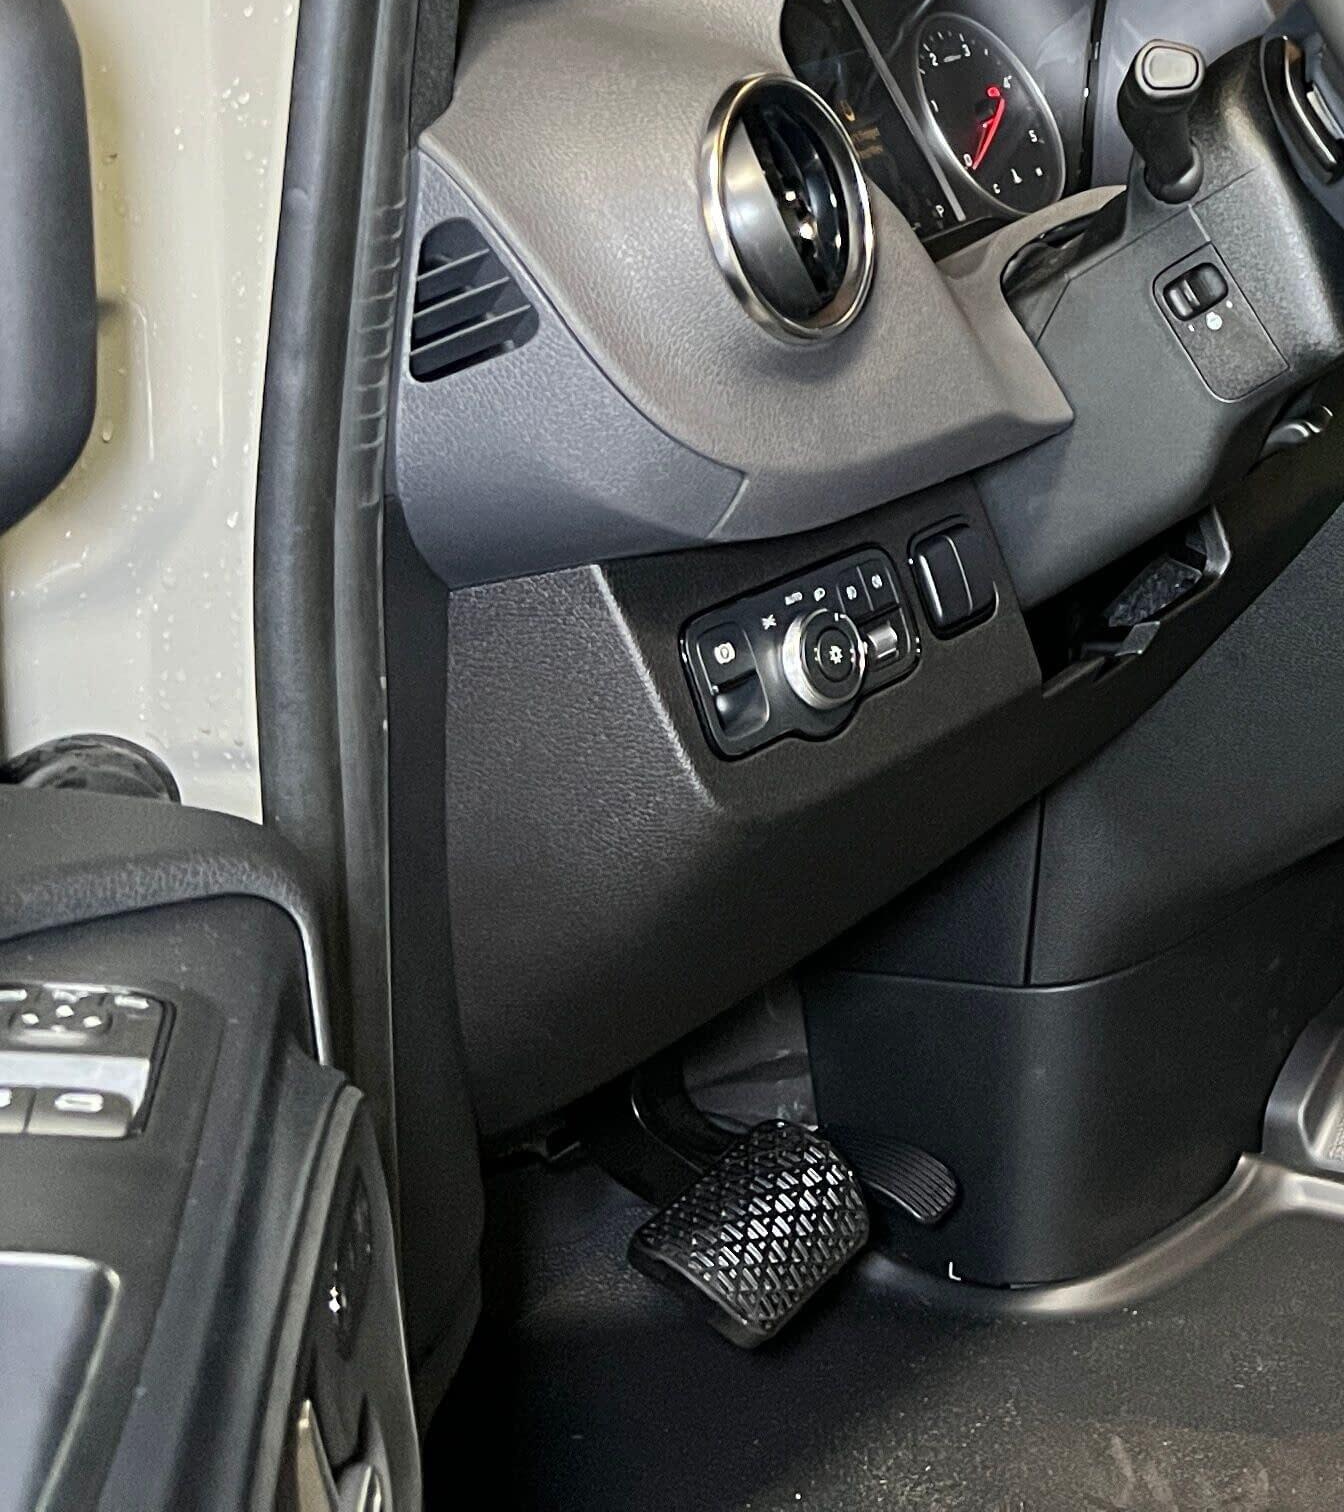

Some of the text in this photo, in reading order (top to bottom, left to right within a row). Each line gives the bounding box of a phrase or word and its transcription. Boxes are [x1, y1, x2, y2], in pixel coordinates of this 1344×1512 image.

[929, 52, 939, 67] 2
[1028, 129, 1039, 143] 5
[963, 153, 973, 167] 0
